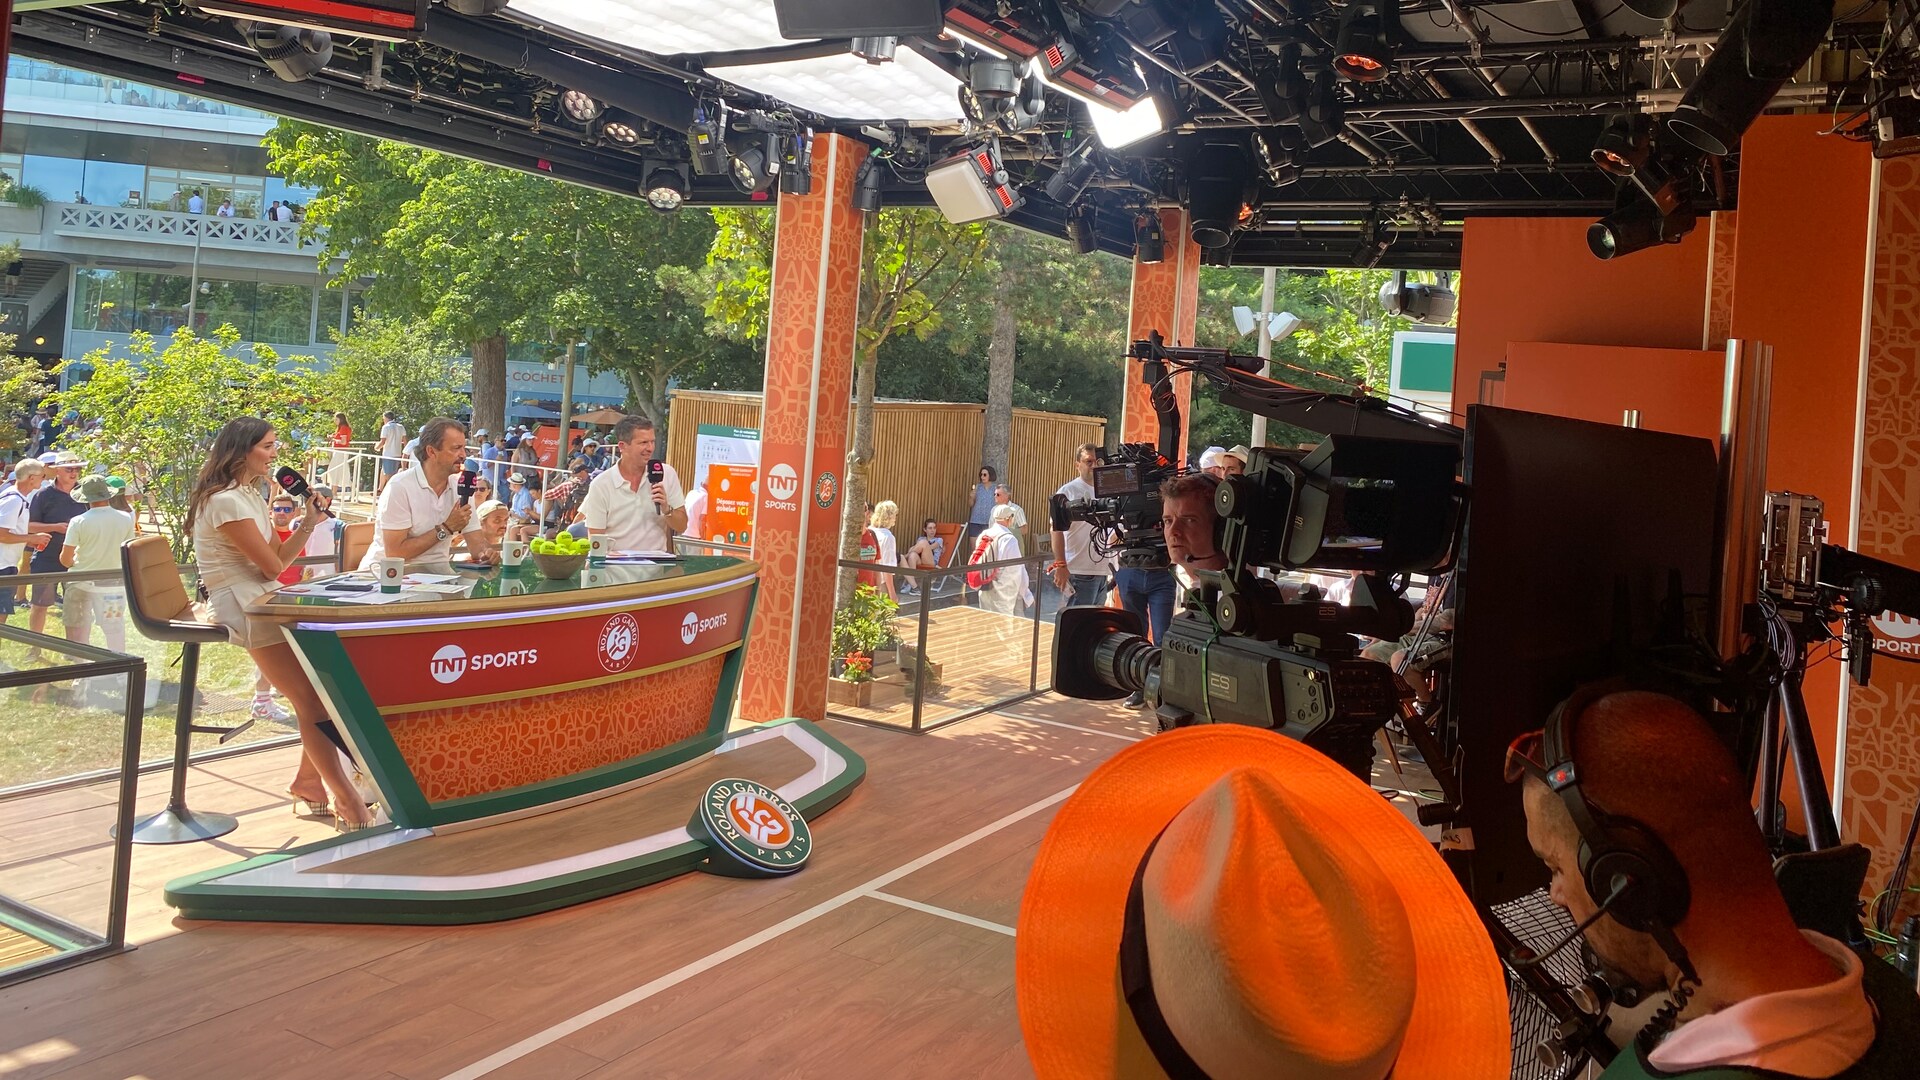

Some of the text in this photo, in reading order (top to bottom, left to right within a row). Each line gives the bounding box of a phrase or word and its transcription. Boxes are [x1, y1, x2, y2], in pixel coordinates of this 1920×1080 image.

[512, 371, 565, 384] COCHET
[738, 507, 749, 516] ICI
[764, 500, 797, 512] SPORTS
[699, 613, 728, 633] SPORTS
[600, 616, 638, 652] ROLAND GARROS
[1872, 638, 1920, 655] PORT
[471, 649, 538, 671] SPORTS
[604, 655, 631, 668] PARIS
[1210, 672, 1230, 690] ES
[711, 782, 799, 840] ROLAND GARROS
[757, 835, 806, 860] PARIS
